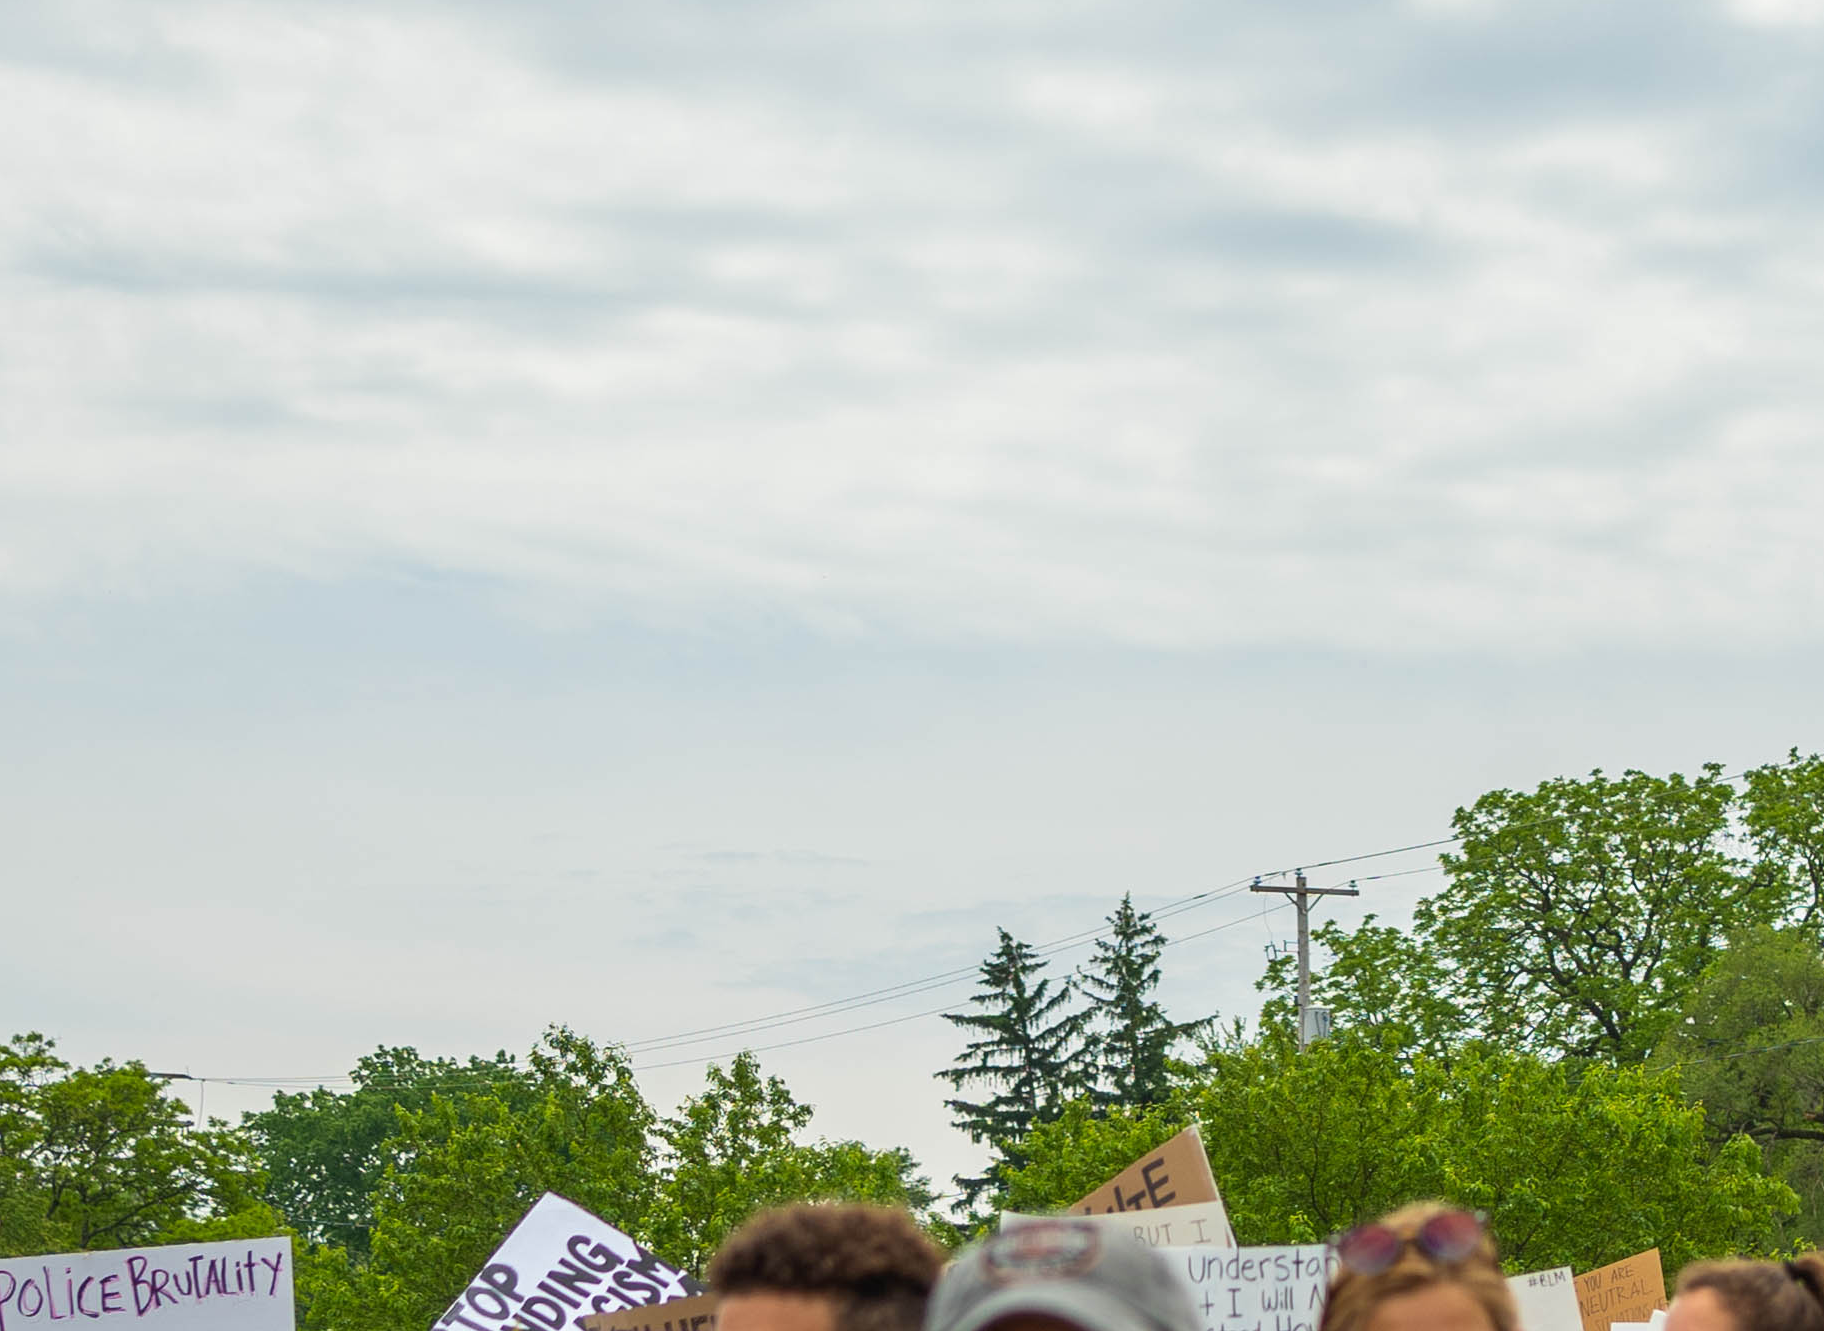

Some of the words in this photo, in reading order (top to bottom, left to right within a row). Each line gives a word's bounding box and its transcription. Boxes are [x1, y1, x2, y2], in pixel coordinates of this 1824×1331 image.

[1528, 1272, 1566, 1288] #BLM
[1584, 1273, 1602, 1293] YOU
[1611, 1264, 1635, 1283] ARE
[1579, 1279, 1654, 1317] NEUTRAL
